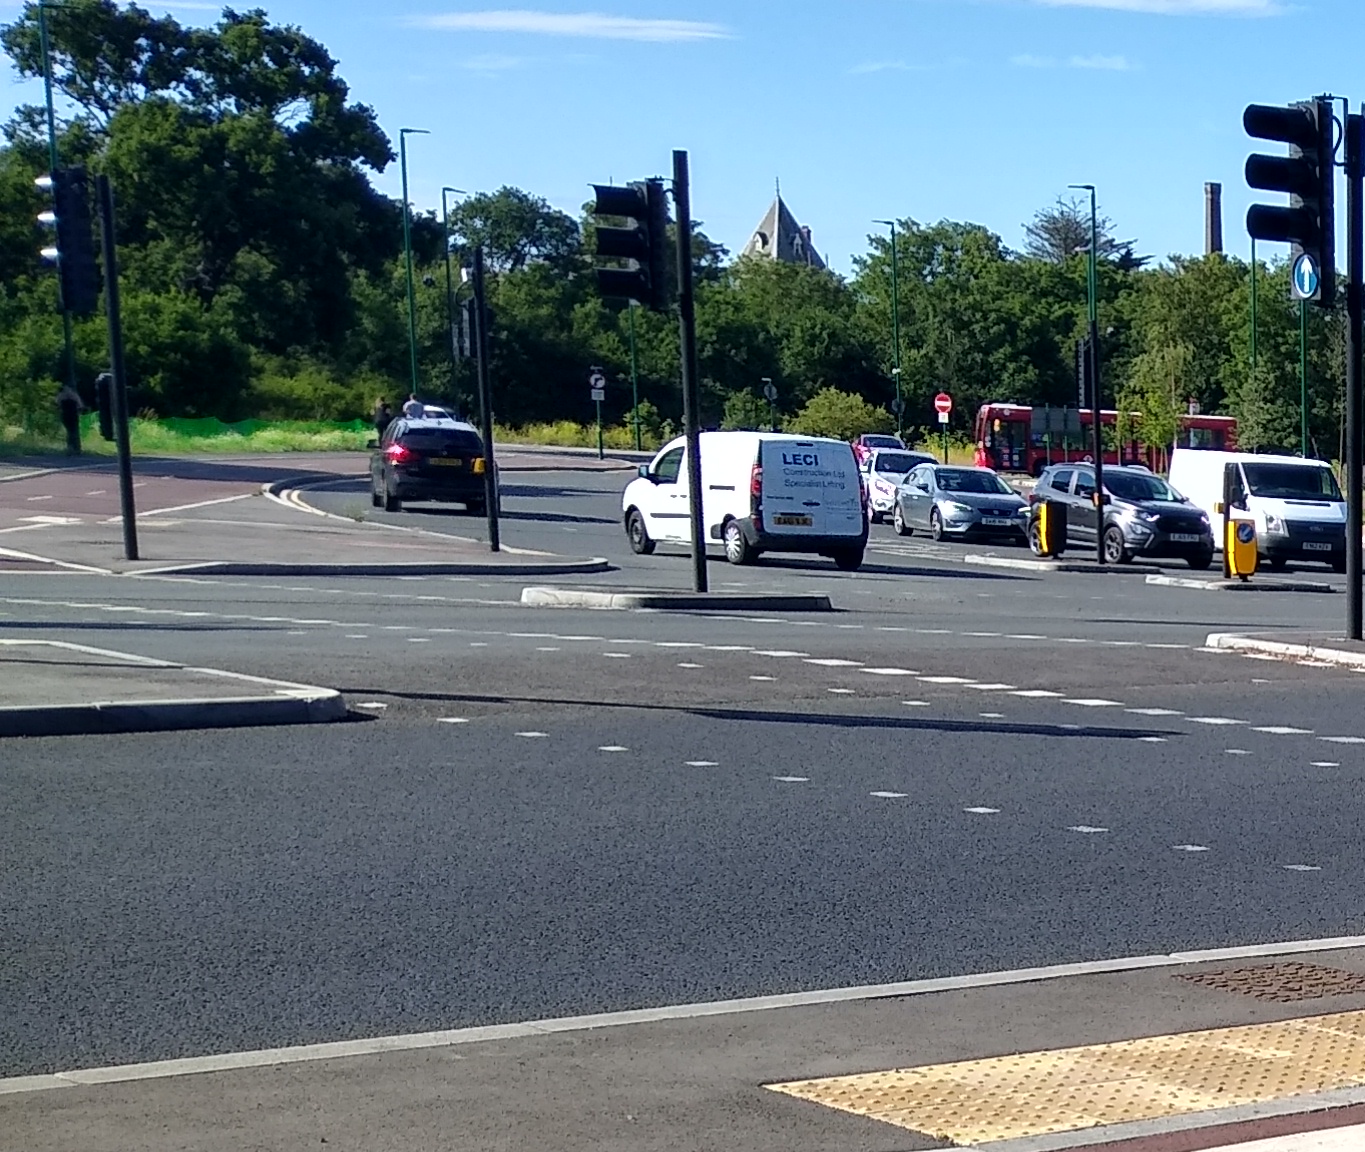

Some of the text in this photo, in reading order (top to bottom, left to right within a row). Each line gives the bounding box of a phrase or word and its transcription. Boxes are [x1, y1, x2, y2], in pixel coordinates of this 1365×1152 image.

[782, 453, 819, 466] LECI
[783, 468, 845, 478] Construction Ltd
[784, 479, 821, 488] Specialist
